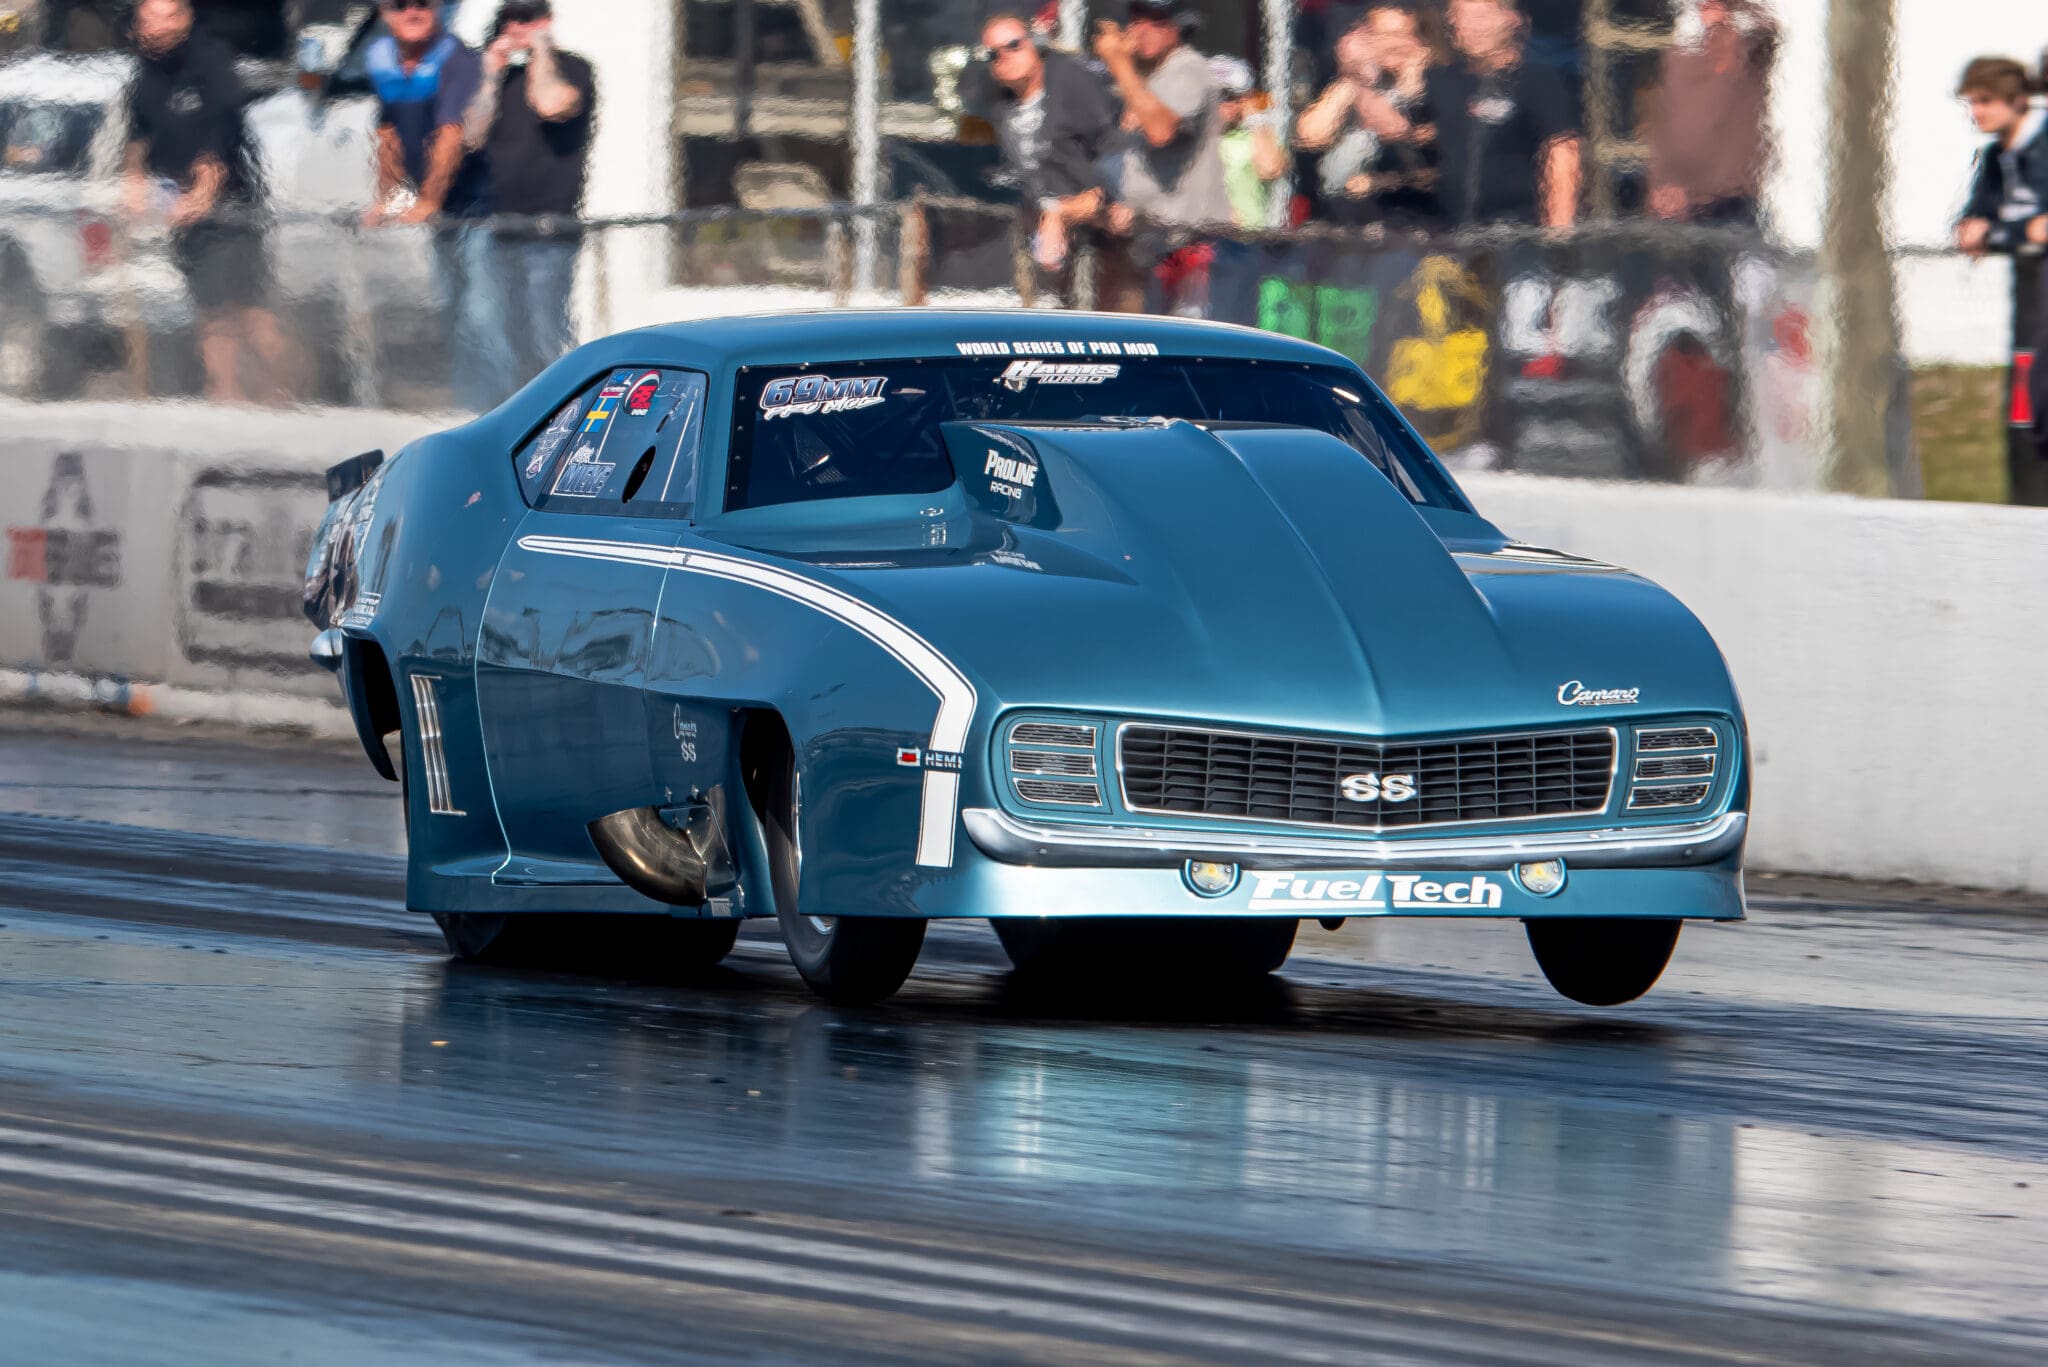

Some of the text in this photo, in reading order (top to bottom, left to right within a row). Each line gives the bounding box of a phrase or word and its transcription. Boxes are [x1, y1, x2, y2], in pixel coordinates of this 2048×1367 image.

[956, 342, 1159, 355] WORLD SERIES OF PRO MOD
[760, 375, 887, 407] 69MM
[984, 449, 1038, 487] PROLINE
[990, 481, 1022, 499] RACING
[1557, 680, 1640, 705] Camaro
[1341, 772, 1417, 802] SS
